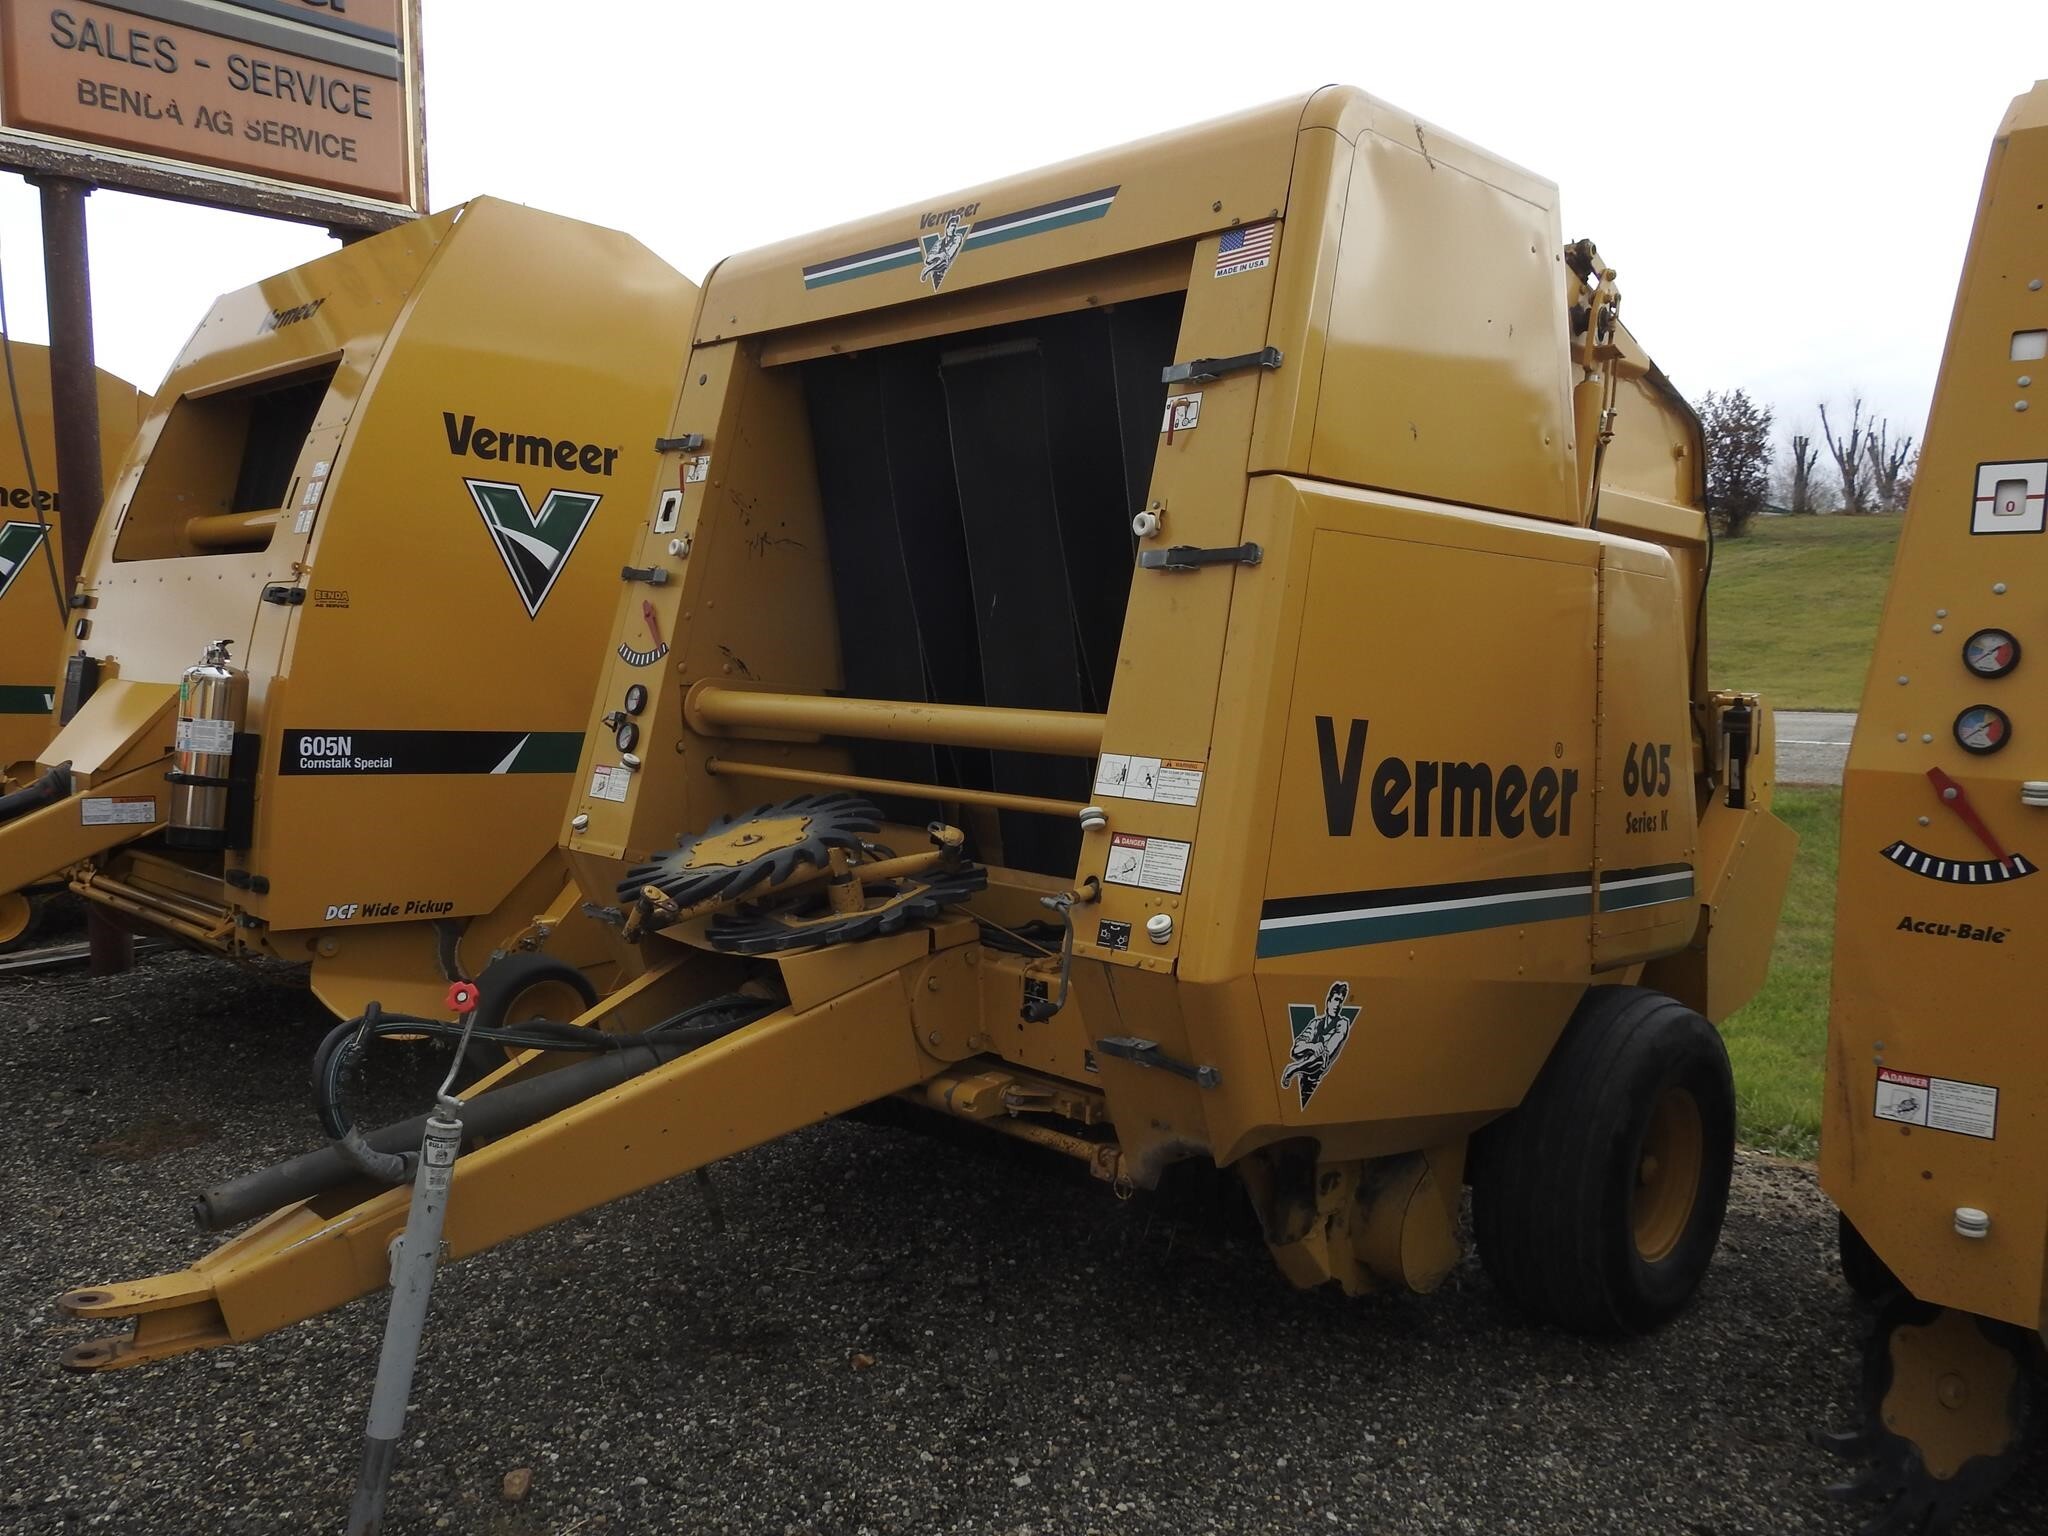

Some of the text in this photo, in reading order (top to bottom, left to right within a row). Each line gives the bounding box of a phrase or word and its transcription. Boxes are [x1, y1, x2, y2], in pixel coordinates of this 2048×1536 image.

[50, 9, 178, 74] SALES
[227, 53, 373, 120] SERVICE
[194, 106, 234, 137] AG
[243, 119, 358, 163] SERVICE
[920, 202, 981, 229] Vermeer
[1216, 260, 1264, 277] MADE IN USA
[443, 411, 618, 477] Vermeer
[314, 589, 349, 601] BENDA
[300, 736, 352, 757] 605N
[300, 757, 393, 771] Cornstalk Special
[1314, 714, 1579, 840] Vermeer
[1623, 742, 1672, 798] 605
[1625, 809, 1669, 835] Series K
[1121, 837, 1146, 848] DANGER
[325, 899, 454, 921] DCF Wide Pickup
[1896, 916, 2006, 944] Accu-Bale
[1890, 1073, 1928, 1087] DANGER
